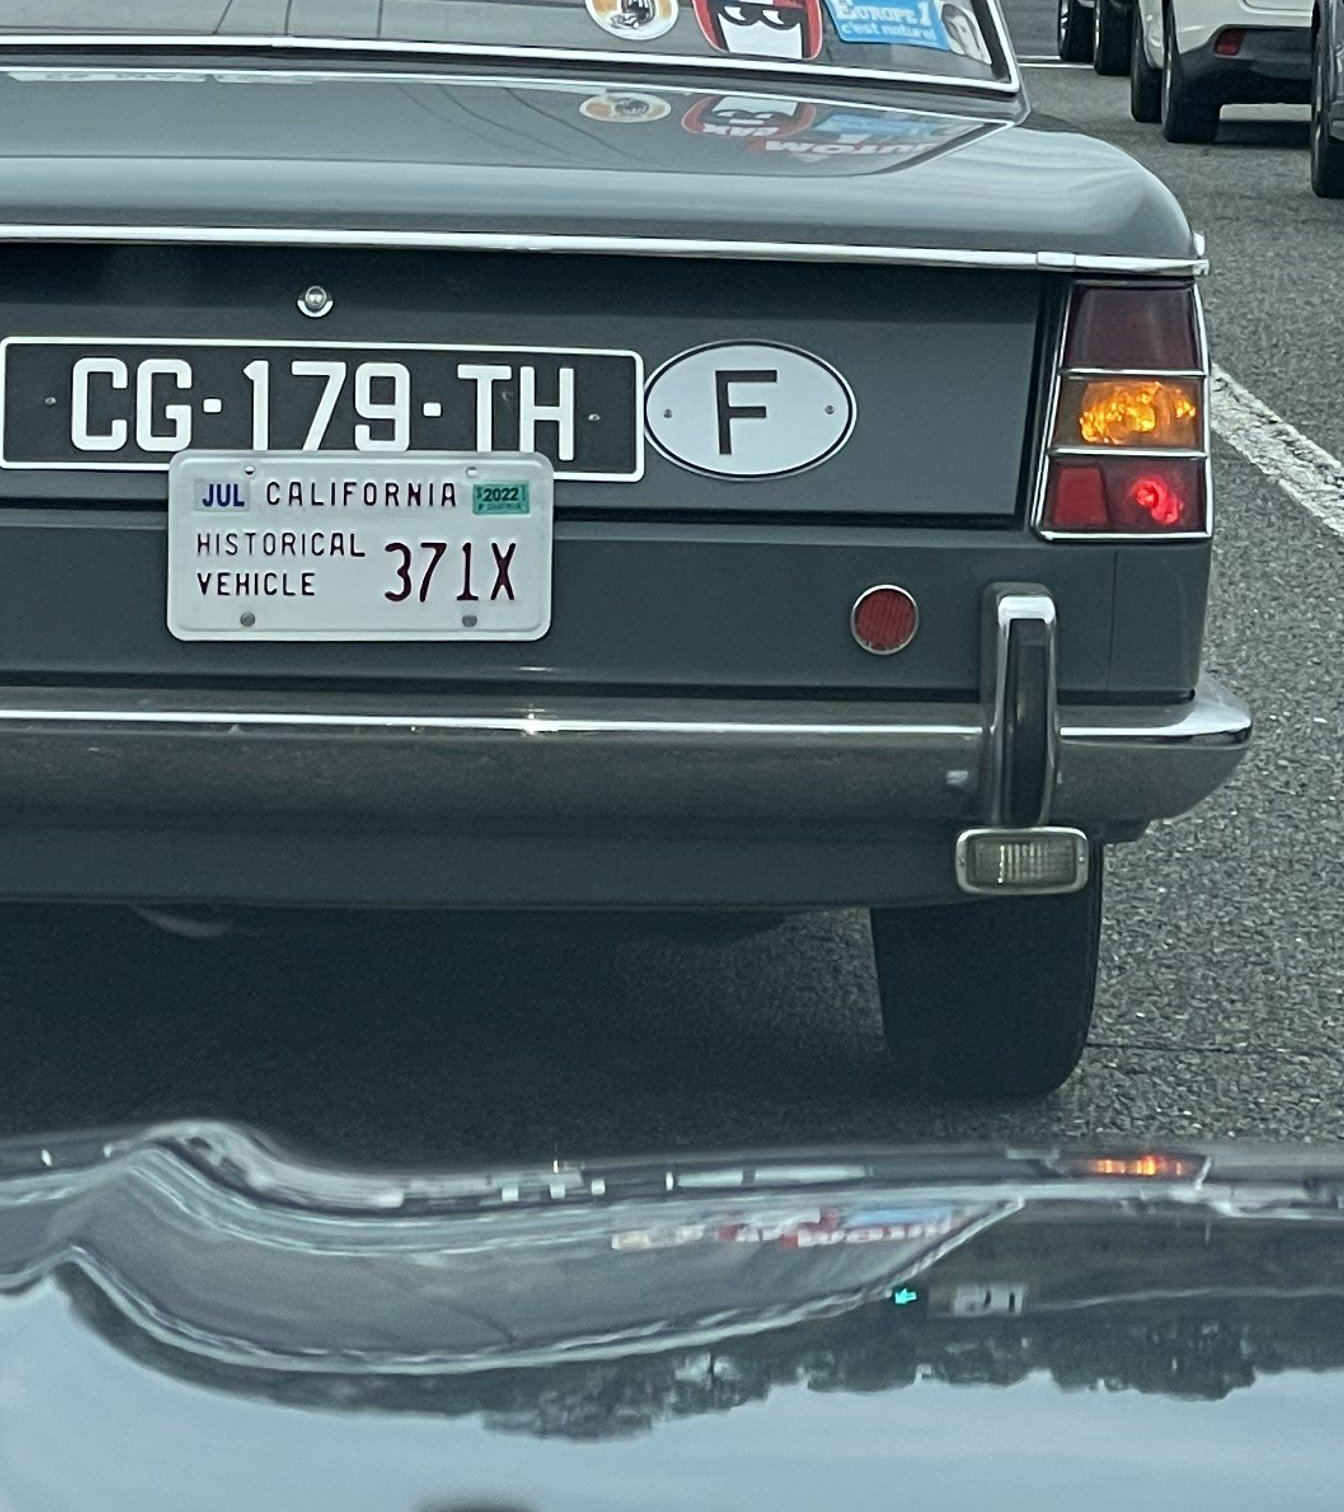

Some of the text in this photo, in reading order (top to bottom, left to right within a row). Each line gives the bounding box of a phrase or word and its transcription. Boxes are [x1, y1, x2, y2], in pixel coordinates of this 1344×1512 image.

[715, 369, 778, 455] F
[201, 483, 246, 508] JUL
[265, 481, 457, 508] CALIFORNIA
[482, 487, 520, 502] 2022
[196, 533, 366, 558] HISTORICAL
[196, 572, 316, 597] VEHICLE
[383, 541, 517, 603] 371X
